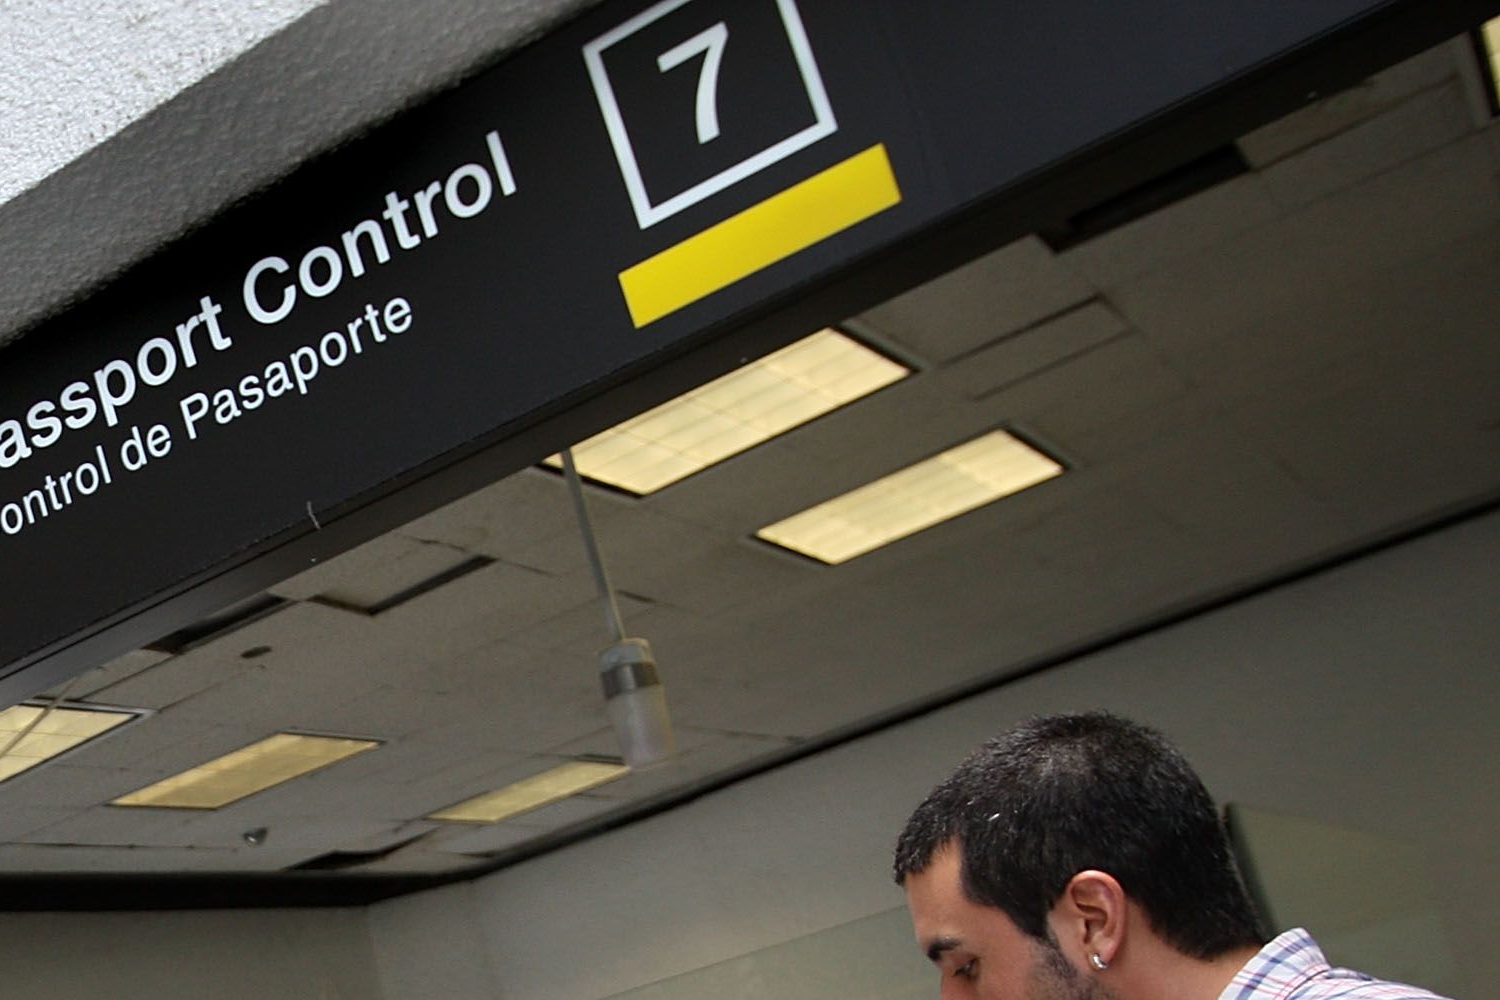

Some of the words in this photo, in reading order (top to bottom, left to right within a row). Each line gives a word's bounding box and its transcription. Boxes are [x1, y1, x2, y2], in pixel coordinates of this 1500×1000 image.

[657, 22, 729, 144] 7
[243, 131, 518, 325] Control
[120, 425, 172, 471] de
[179, 297, 414, 440] Pasaporte
